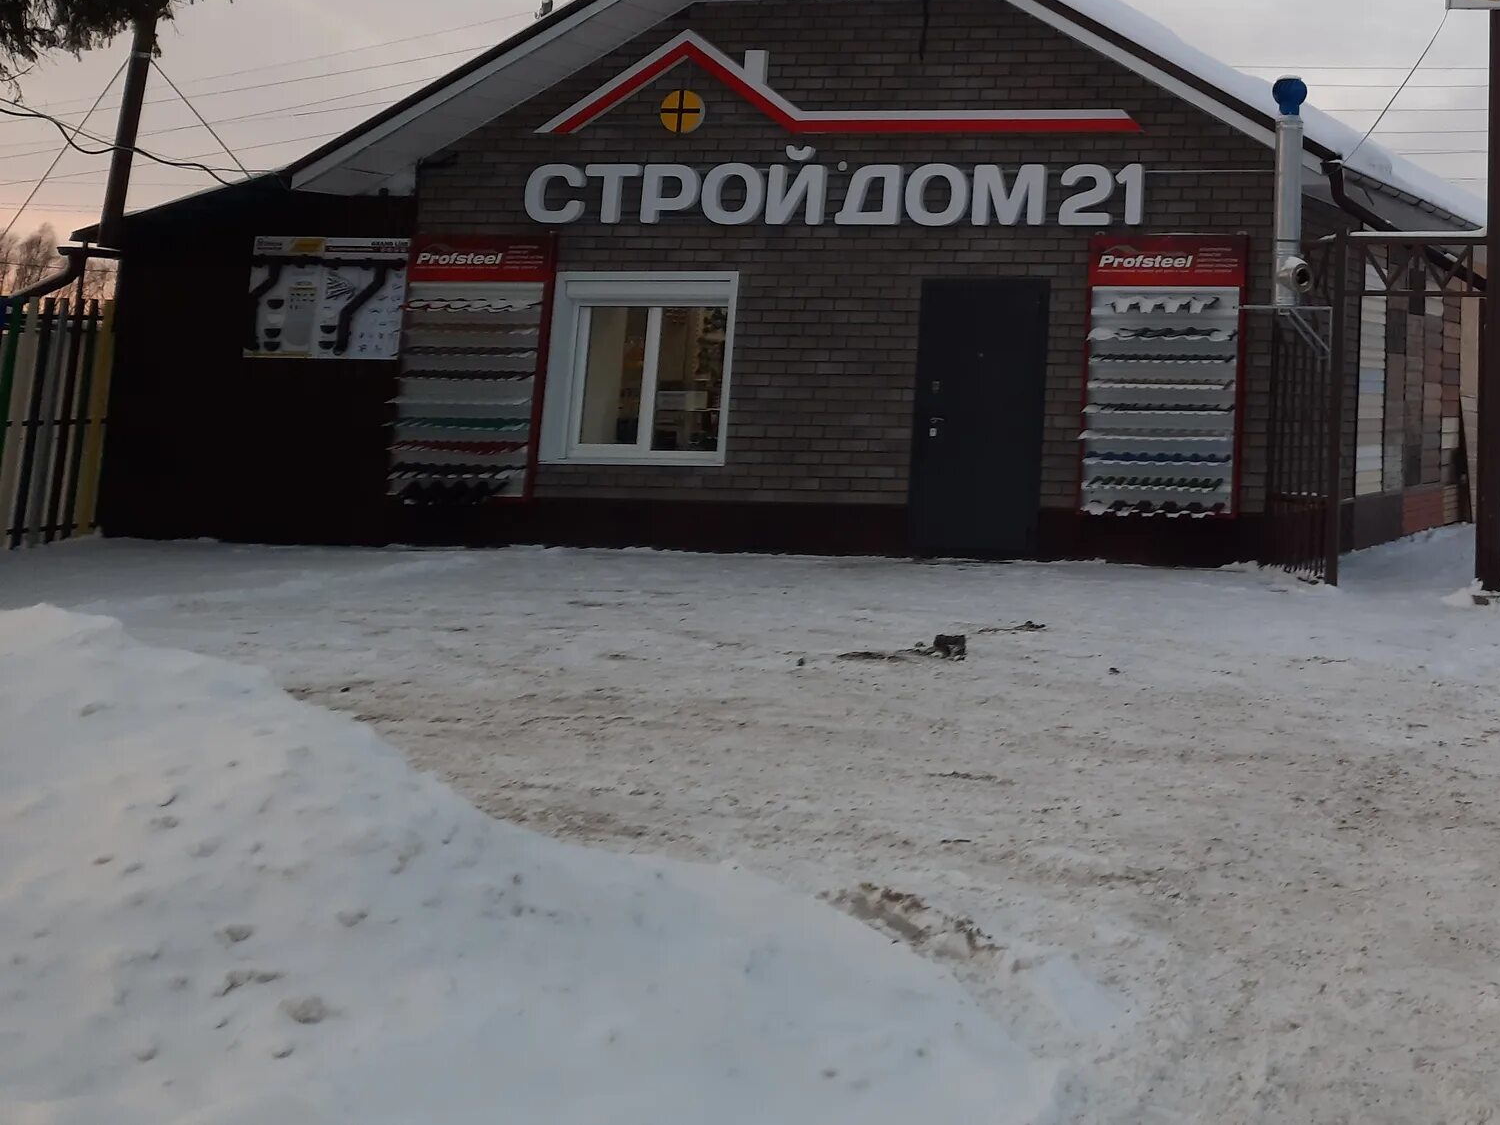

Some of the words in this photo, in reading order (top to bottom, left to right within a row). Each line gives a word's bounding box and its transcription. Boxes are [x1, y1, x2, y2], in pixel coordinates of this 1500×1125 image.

[524, 145, 828, 226] СТРОЙ
[834, 162, 1049, 227] ДОМ
[1058, 162, 1146, 227] 21
[416, 252, 504, 266] Profsteel
[1098, 254, 1194, 268] Profsteel
